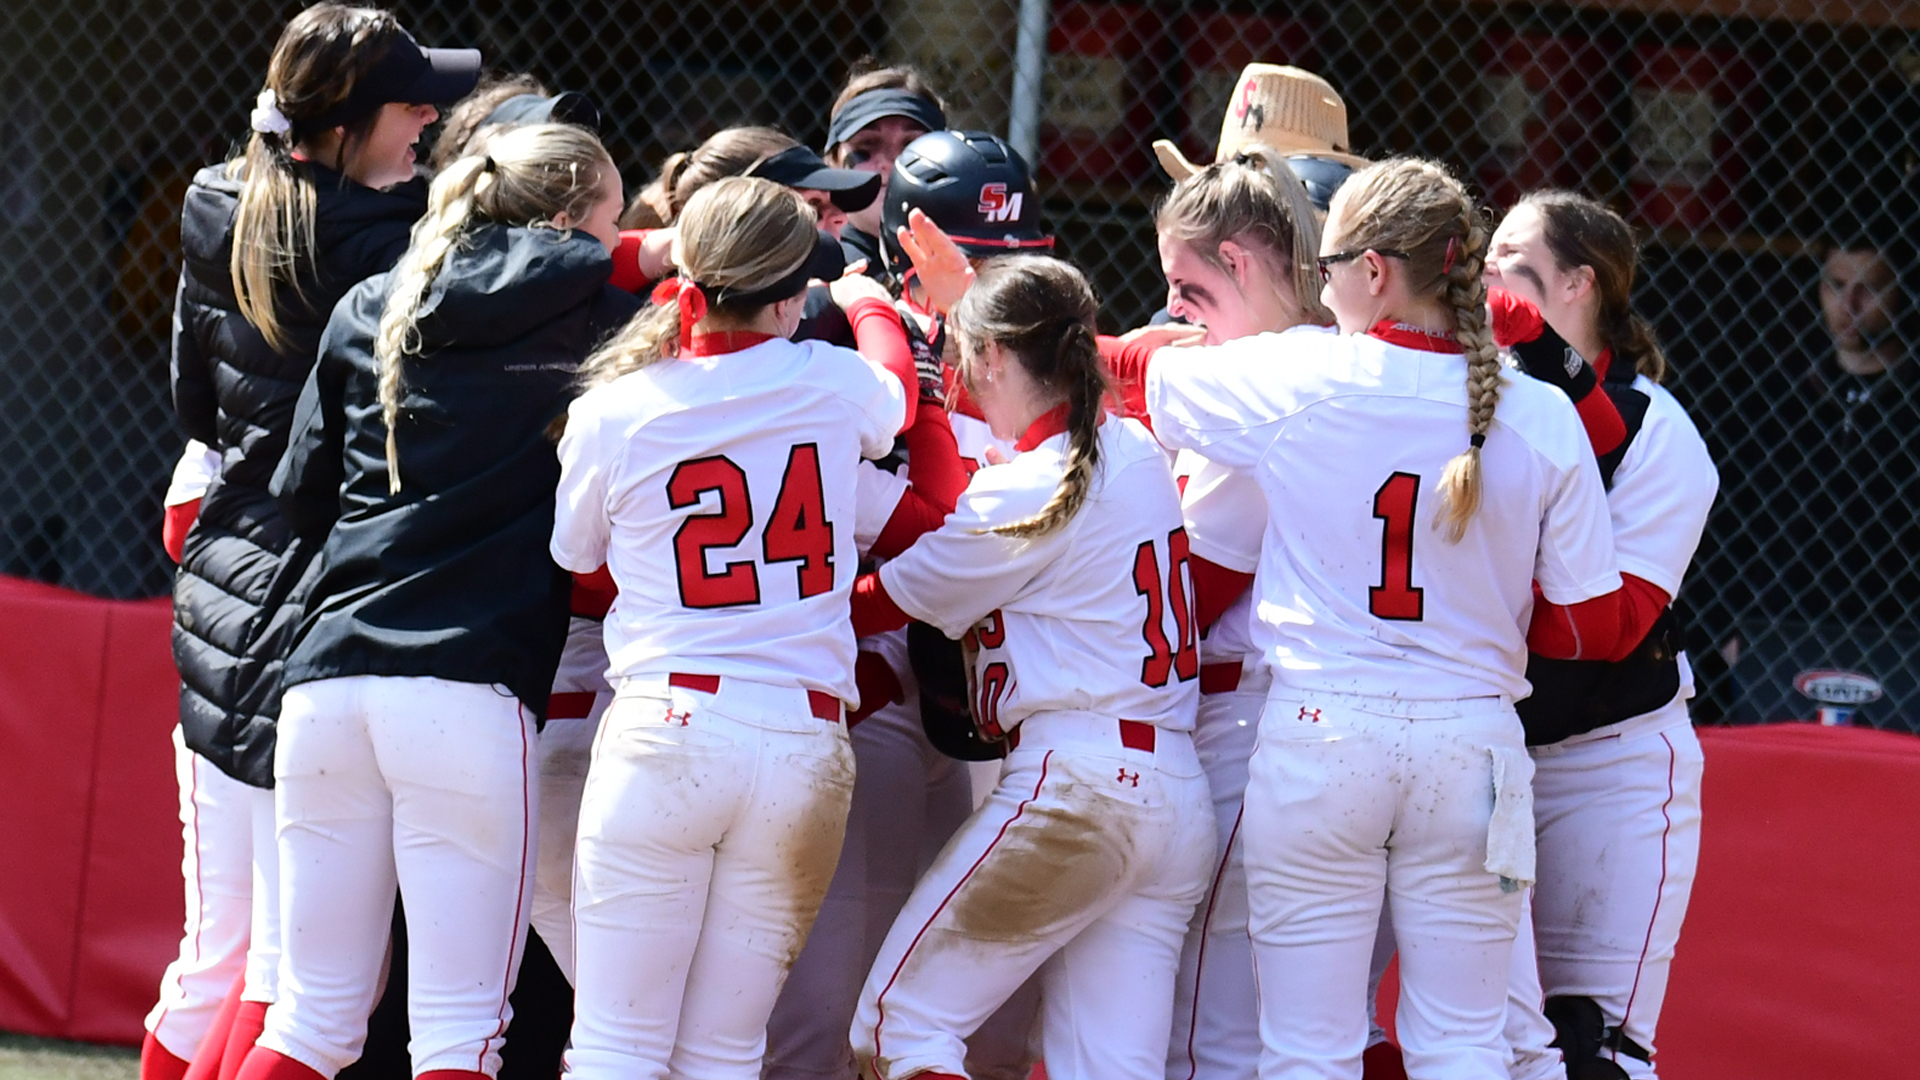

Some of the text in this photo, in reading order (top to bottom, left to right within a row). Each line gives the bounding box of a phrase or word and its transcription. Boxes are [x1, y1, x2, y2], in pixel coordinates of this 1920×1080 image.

[977, 182, 1023, 223] SM
[504, 362, 537, 372] UNDER
[665, 441, 835, 609] 24
[1368, 470, 1424, 622] 1
[1132, 524, 1199, 689] 10
